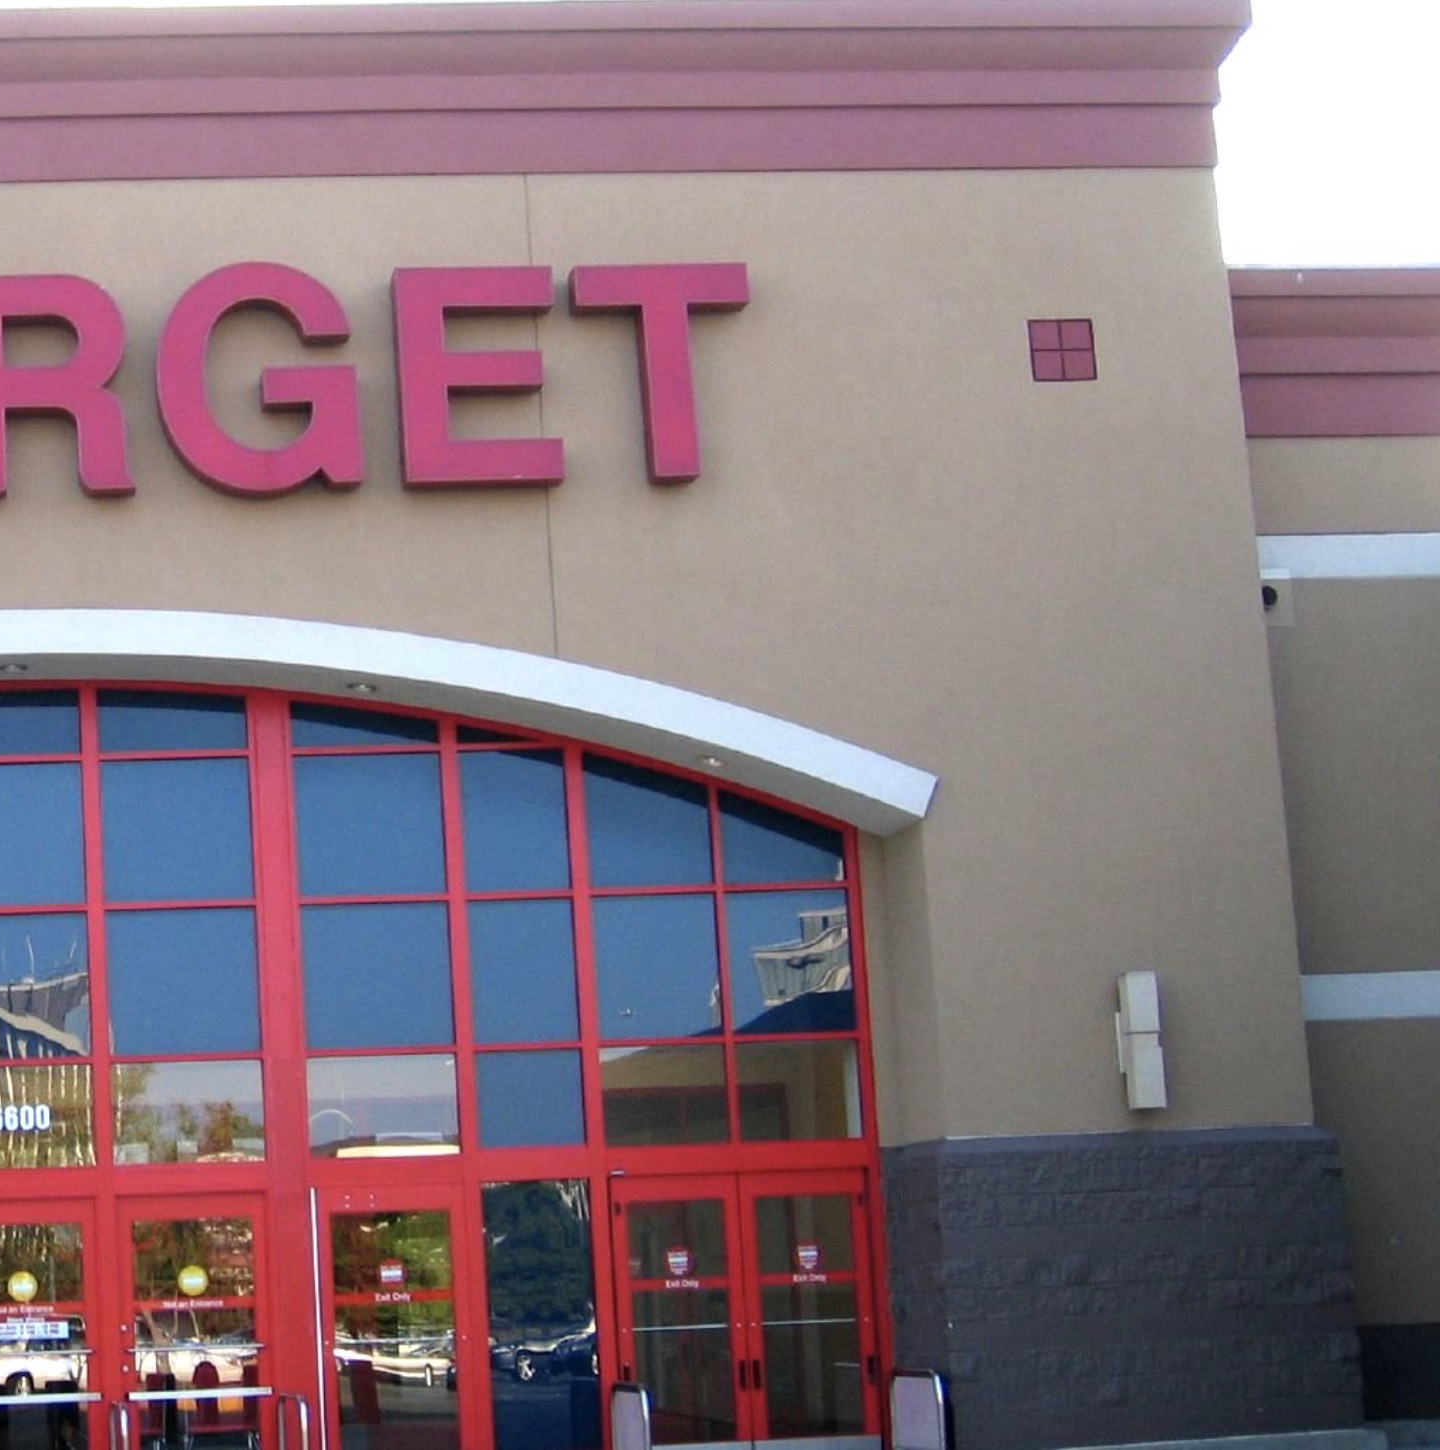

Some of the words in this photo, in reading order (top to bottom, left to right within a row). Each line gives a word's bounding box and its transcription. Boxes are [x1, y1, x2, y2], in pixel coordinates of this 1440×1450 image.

[665, 1280, 680, 1289] Exit
[375, 1293, 390, 1302] Exit
[392, 1292, 410, 1302] Only
